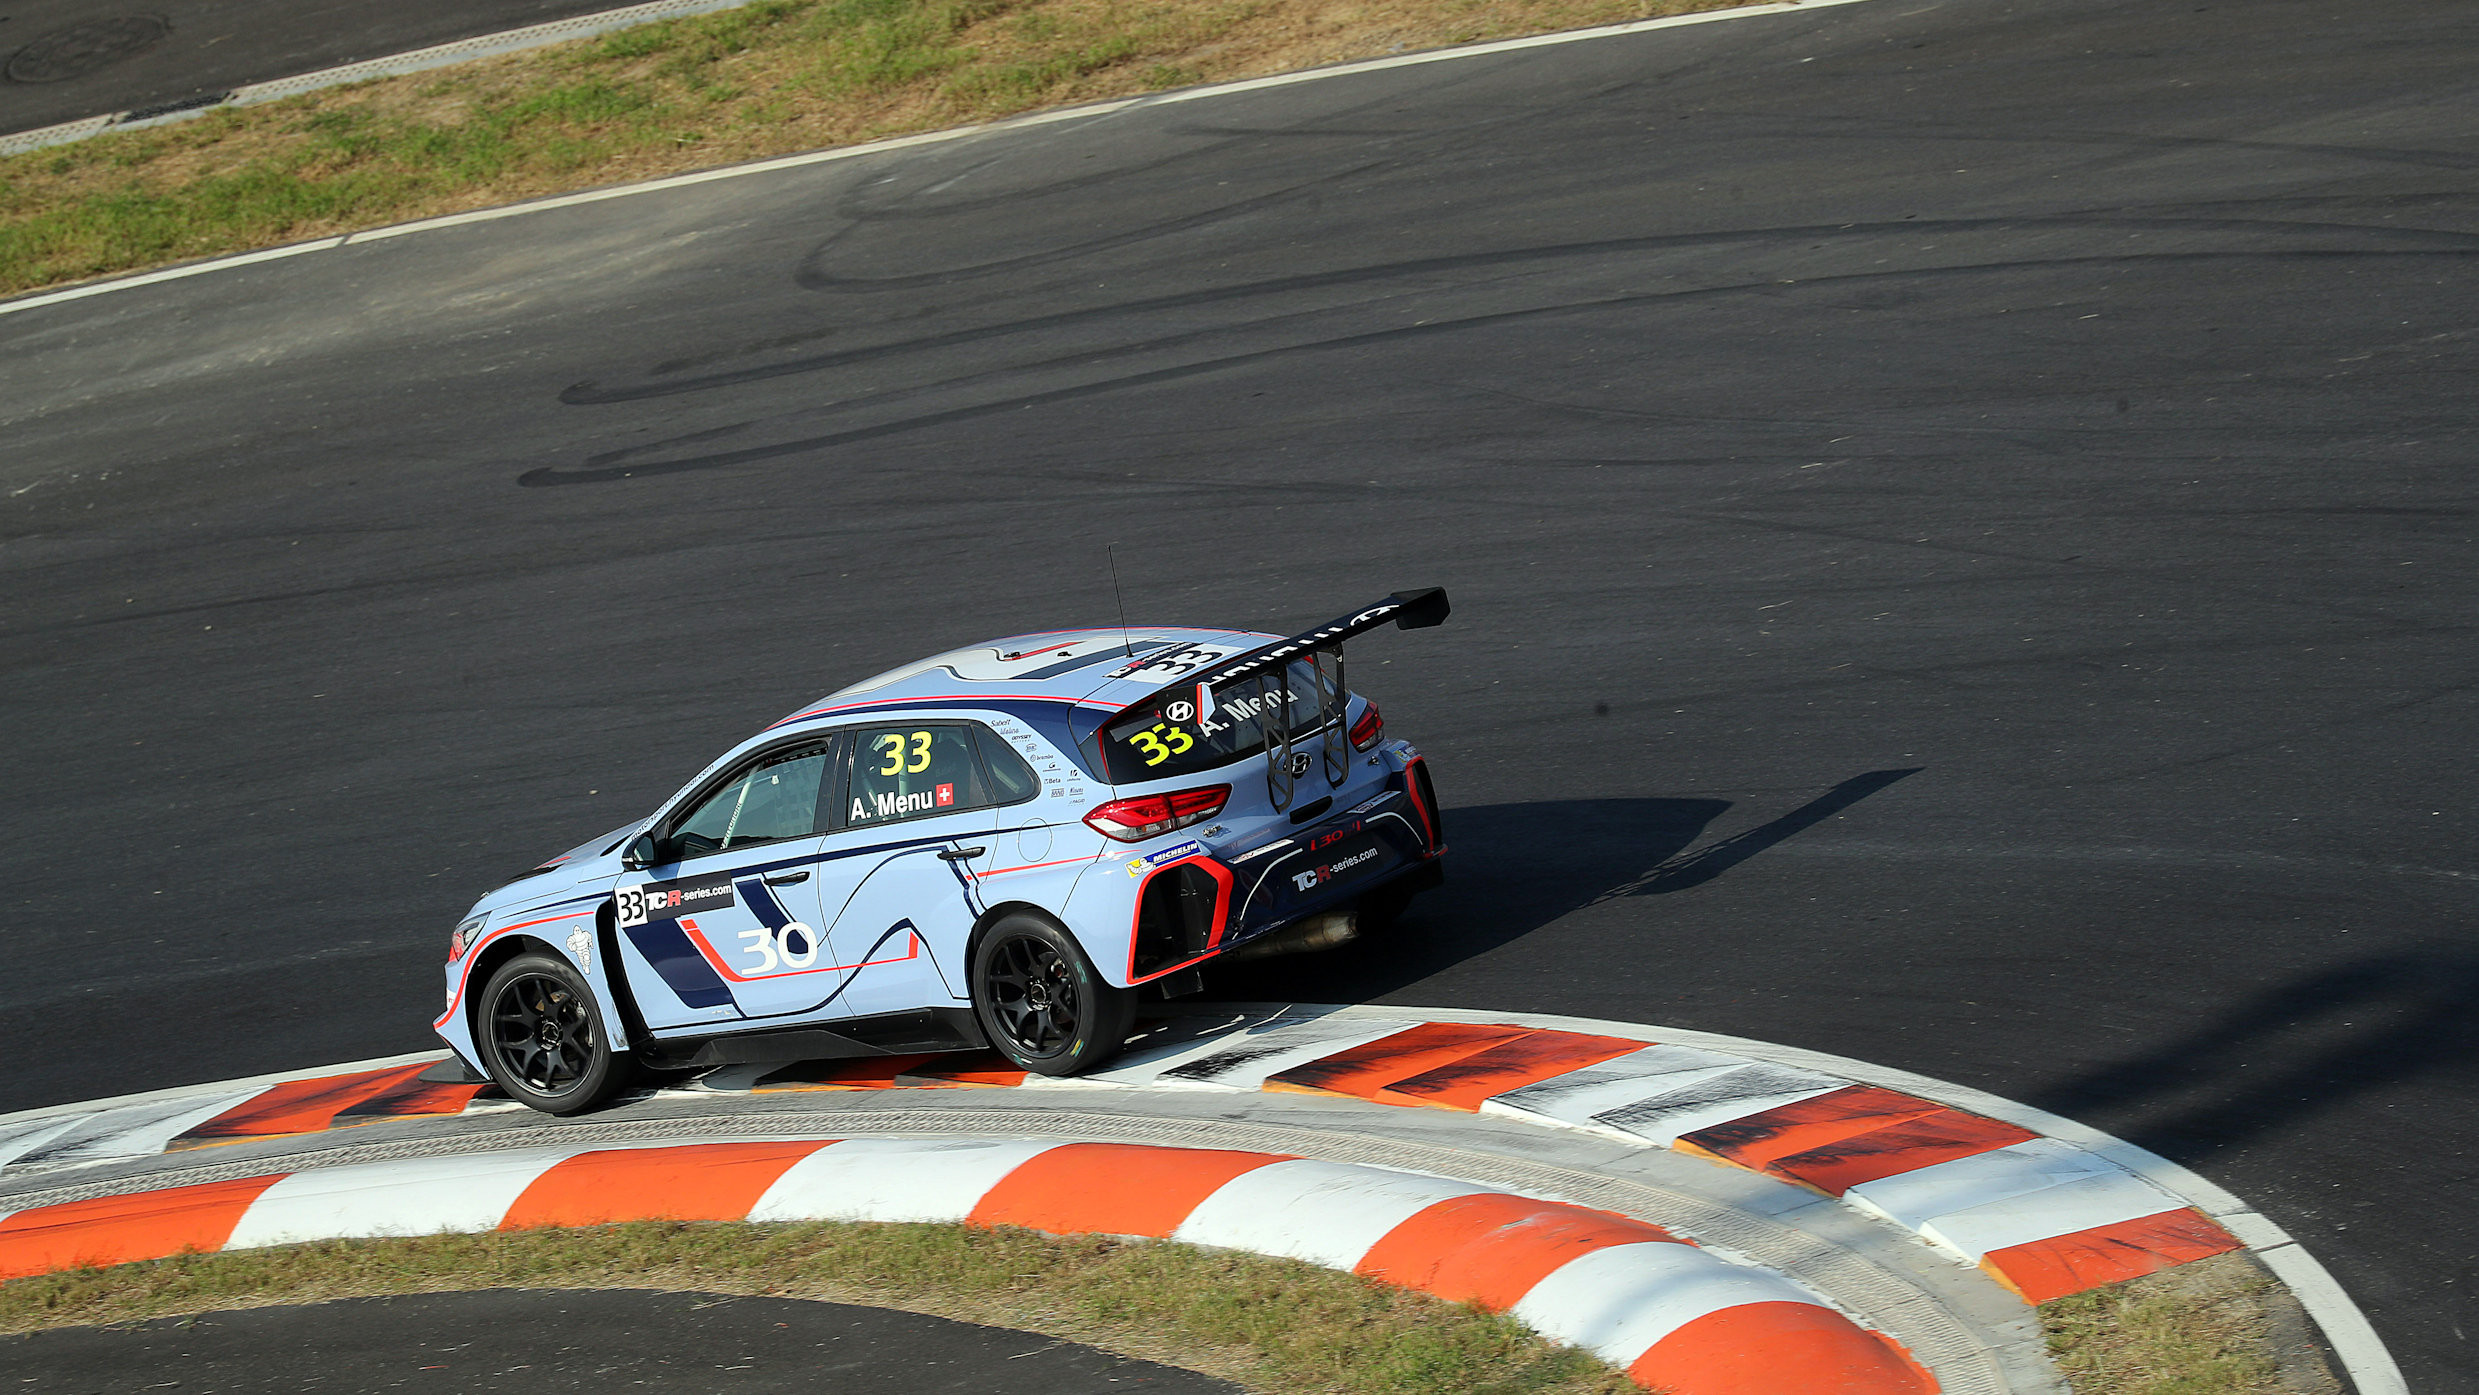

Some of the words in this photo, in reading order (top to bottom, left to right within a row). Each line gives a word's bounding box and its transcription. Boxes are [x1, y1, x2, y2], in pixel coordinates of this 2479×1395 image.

[1137, 650, 1223, 676] 33
[880, 731, 932, 776] 33
[1129, 723, 1194, 767] 33
[851, 797, 872, 821] A.
[877, 791, 933, 816] Menu
[1152, 842, 1198, 863] MICHELIN
[1292, 847, 1378, 892] TCR-series.com
[619, 891, 644, 922] 33
[645, 884, 732, 911] TCR-series.com
[737, 921, 818, 975] 30
